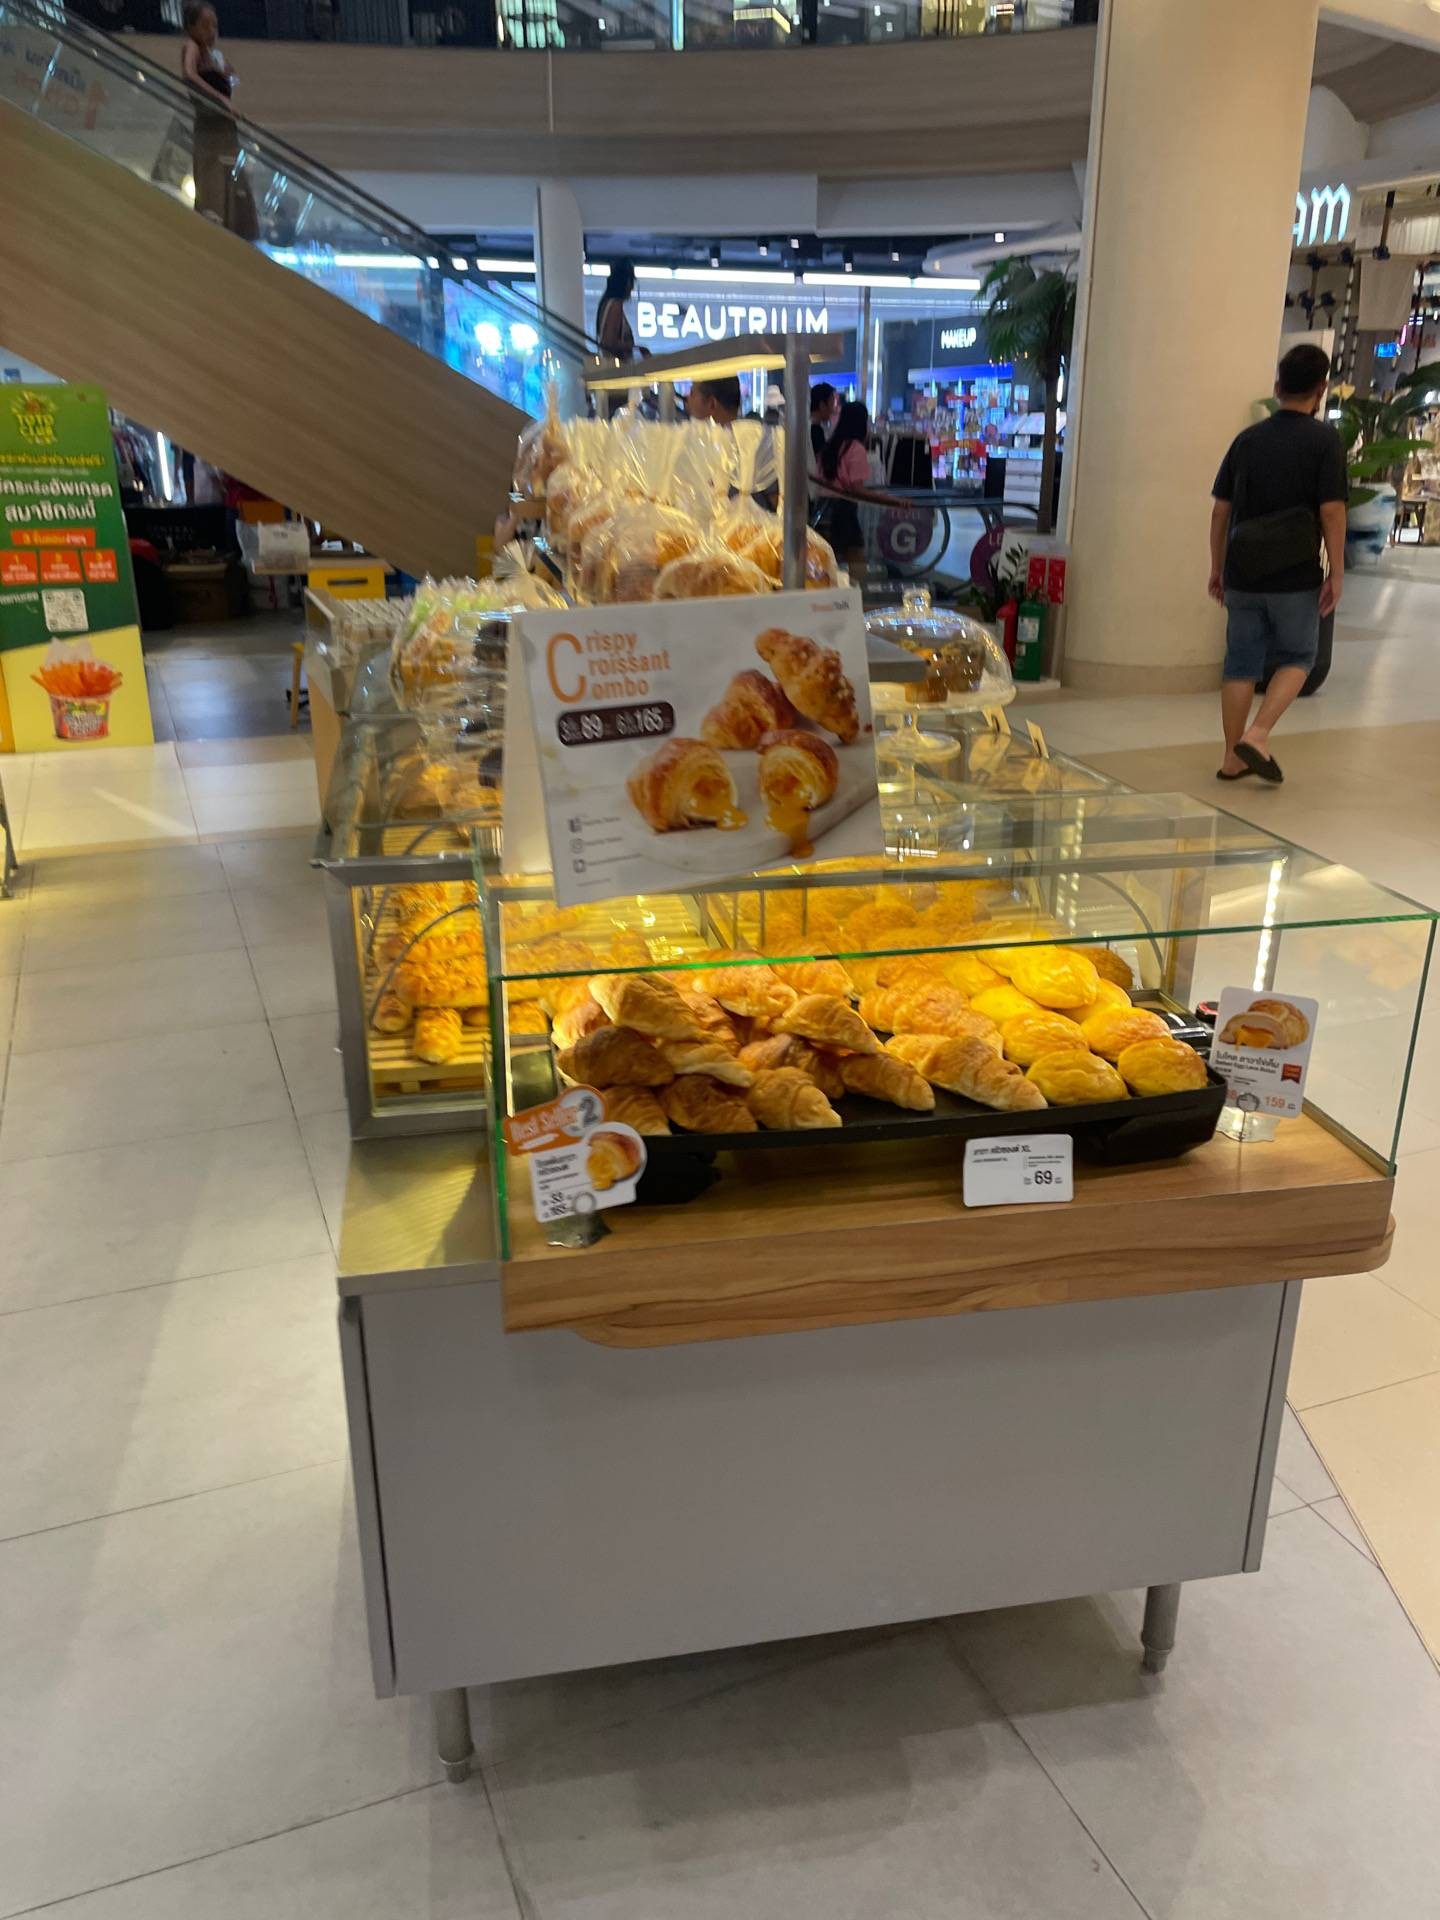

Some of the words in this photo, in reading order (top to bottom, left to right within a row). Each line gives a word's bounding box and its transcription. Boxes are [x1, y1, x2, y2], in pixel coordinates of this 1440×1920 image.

[941, 327, 977, 349] MAKEUP
[890, 522, 917, 555] G
[1034, 1169, 1053, 1186] 69
